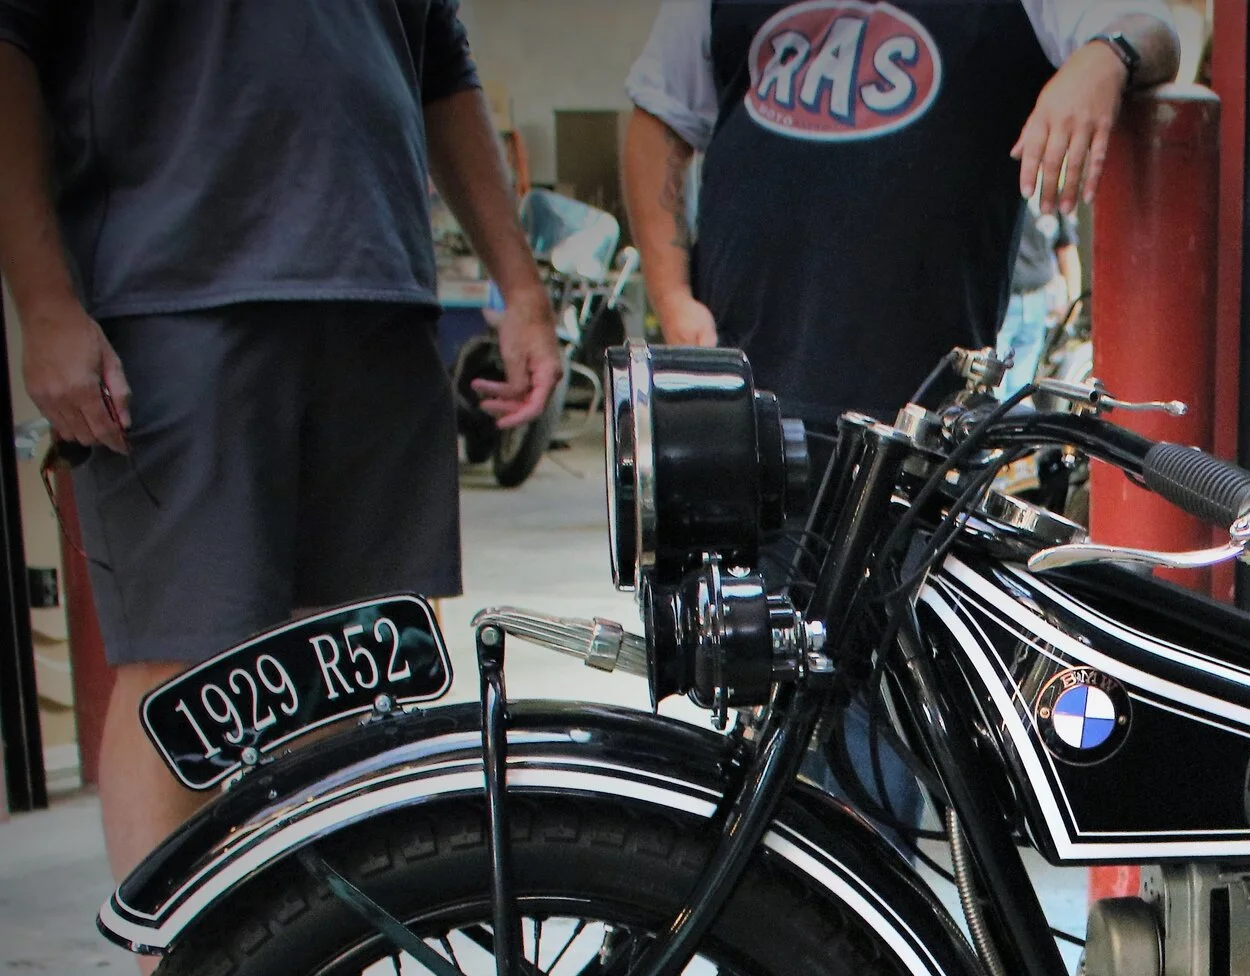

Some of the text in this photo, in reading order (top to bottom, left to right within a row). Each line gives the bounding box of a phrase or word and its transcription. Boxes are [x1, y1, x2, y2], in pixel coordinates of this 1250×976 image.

[757, 16, 918, 126] RAS
[175, 617, 411, 759] 1929 R52
[1061, 669, 1118, 693] BMW
